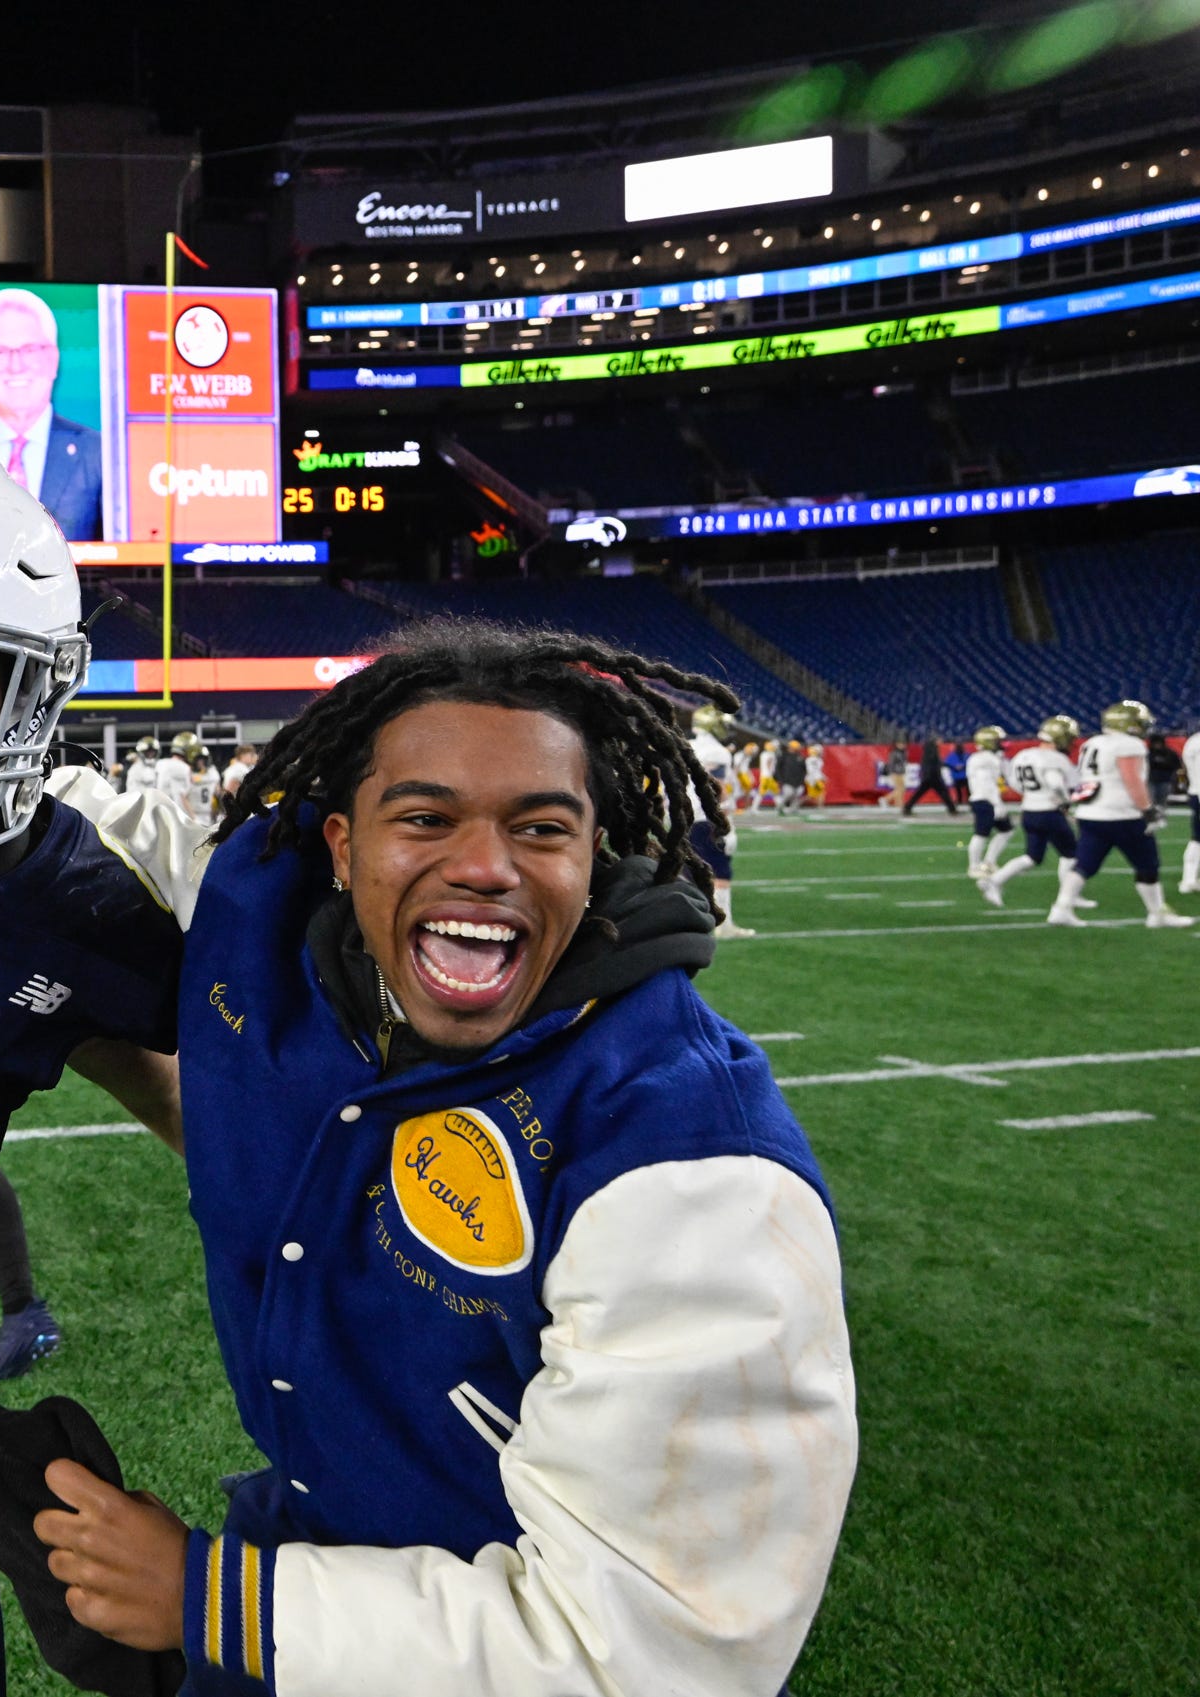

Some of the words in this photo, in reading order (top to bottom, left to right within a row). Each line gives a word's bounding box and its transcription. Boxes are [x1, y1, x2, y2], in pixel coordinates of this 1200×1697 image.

[356, 192, 473, 224] Encore
[487, 198, 560, 216] TERRACE
[365, 225, 413, 238] BOSTON
[415, 224, 463, 236] HARBOR
[866, 318, 957, 348] Gillette
[606, 349, 685, 376] Gillette
[732, 337, 817, 363] Gillette
[190, 375, 252, 396] WEBB
[487, 359, 563, 386] Gillette
[173, 395, 228, 408] COMPANY
[149, 462, 268, 505] Optum
[283, 488, 313, 513] 25
[335, 486, 384, 512] 0:15
[680, 515, 725, 533] 2024
[737, 511, 787, 530] MIAA
[798, 505, 857, 525] STATE
[871, 487, 1057, 521] CHAMPIONSHIPS
[229, 545, 316, 563] EMPOWER
[209, 981, 245, 1034] Coach
[404, 1136, 485, 1242] Hawks
